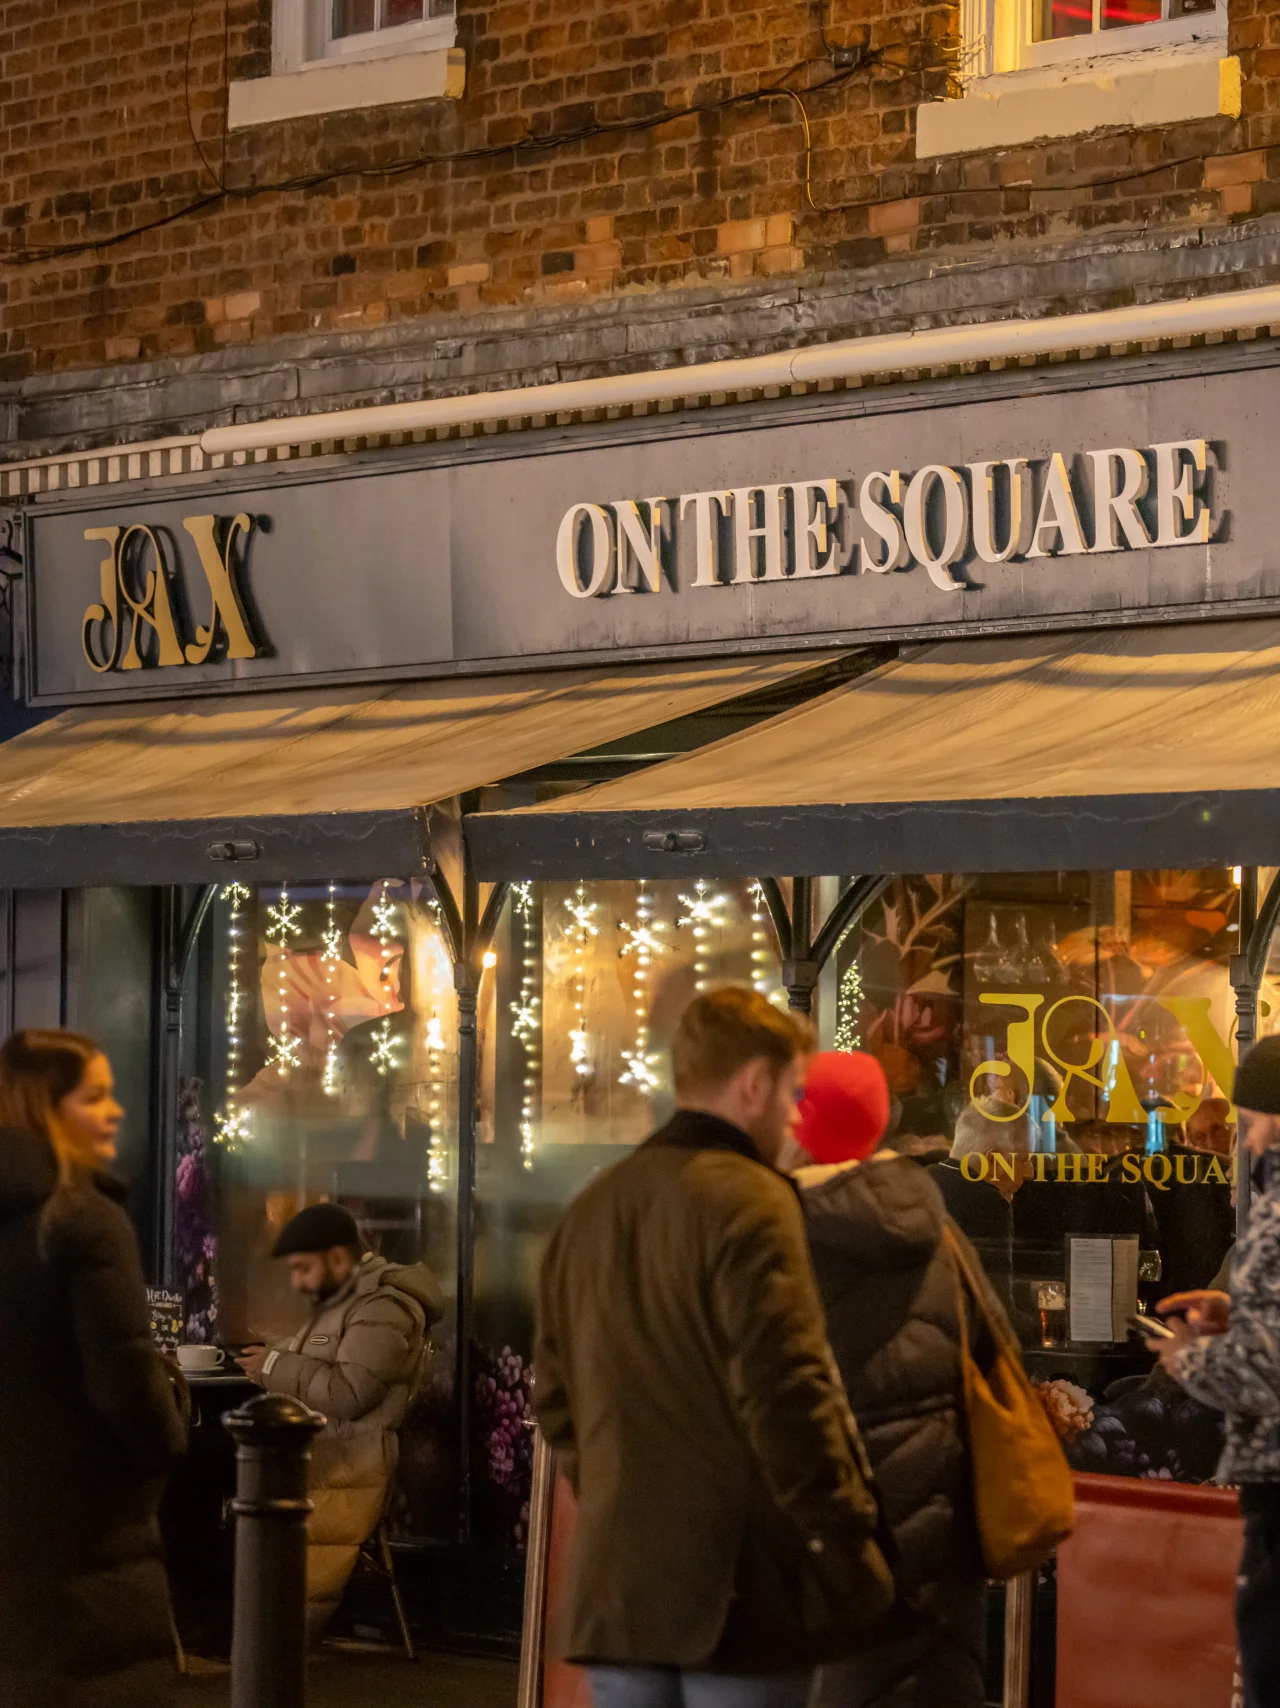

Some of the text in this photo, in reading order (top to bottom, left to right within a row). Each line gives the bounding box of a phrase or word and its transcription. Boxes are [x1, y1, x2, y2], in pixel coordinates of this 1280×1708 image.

[81, 512, 256, 673] JAX
[556, 438, 1210, 599] ON THE SQUARE
[960, 1152, 1239, 1191] ON THE SQUA
